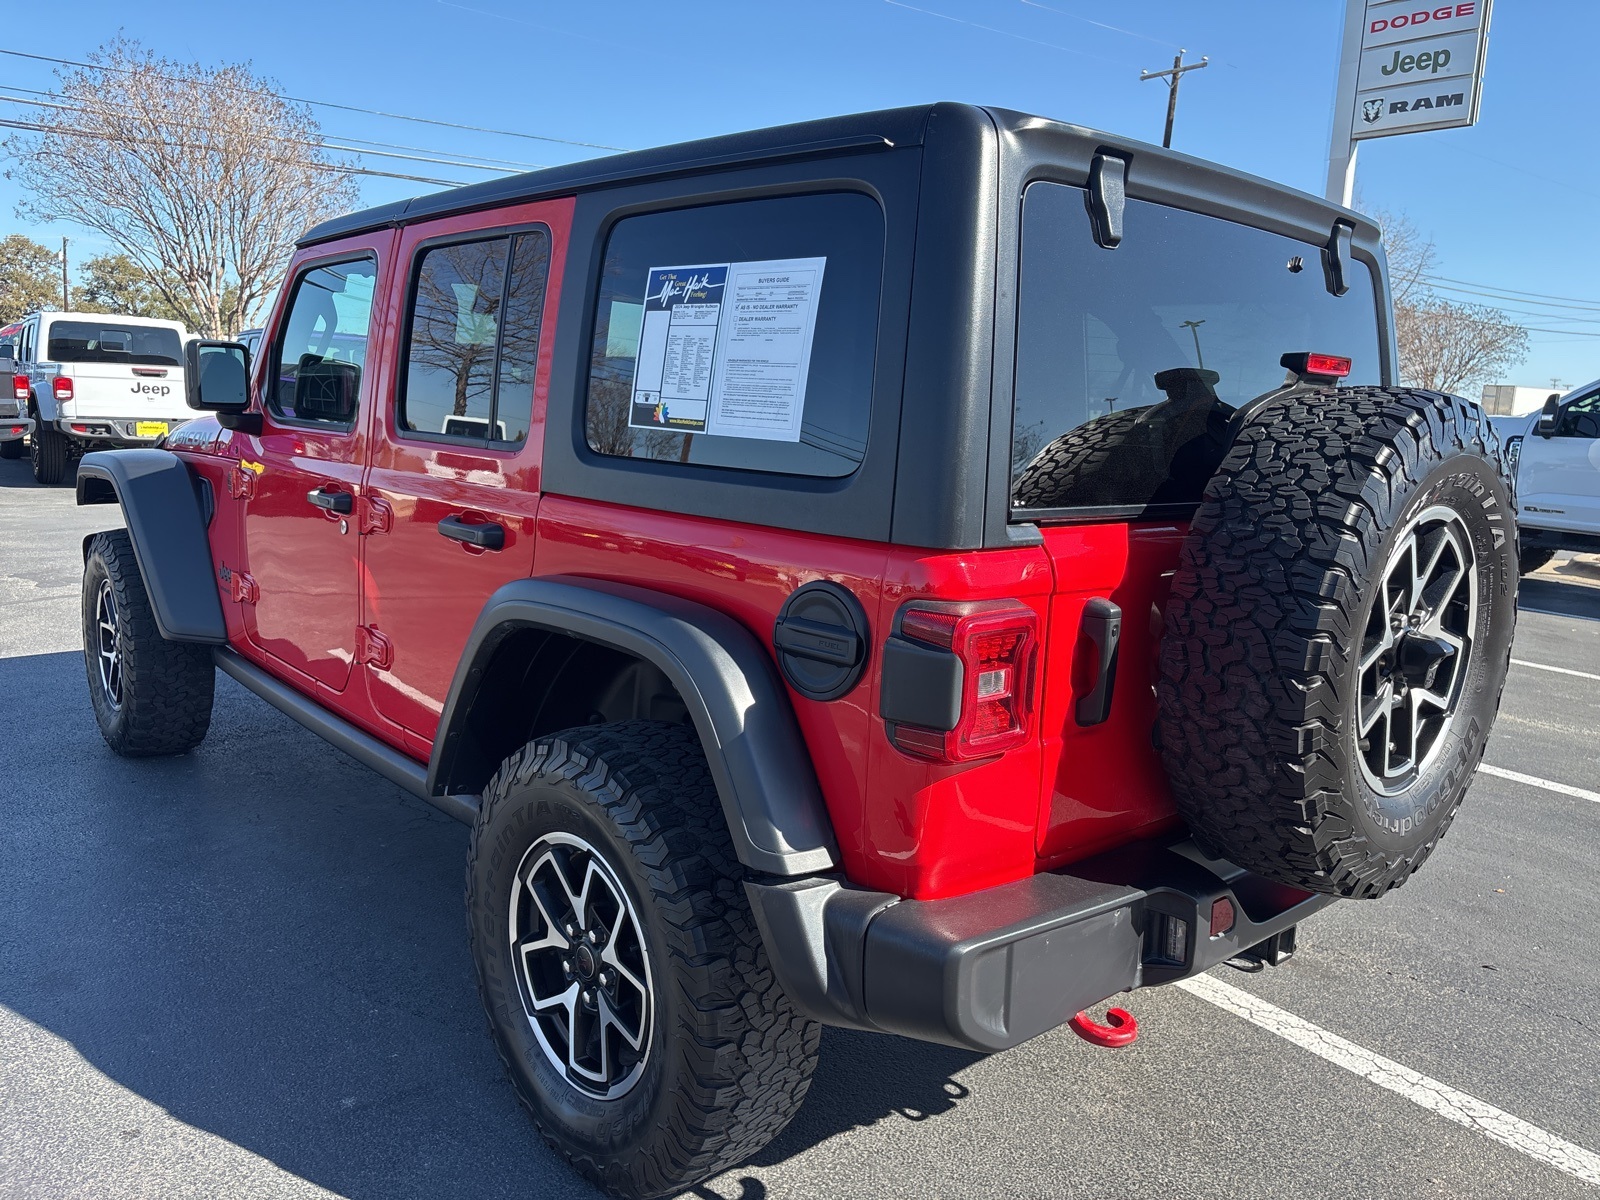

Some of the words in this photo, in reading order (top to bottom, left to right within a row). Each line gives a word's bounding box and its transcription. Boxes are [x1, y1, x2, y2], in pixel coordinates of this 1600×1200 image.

[1370, 2, 1476, 33] DODGE
[1381, 49, 1451, 76] Jeep
[1389, 93, 1464, 115] RAM
[682, 273, 713, 304] Haik
[131, 382, 170, 396] Jeep
[219, 560, 231, 583] Jee
[819, 640, 843, 651] FUEL
